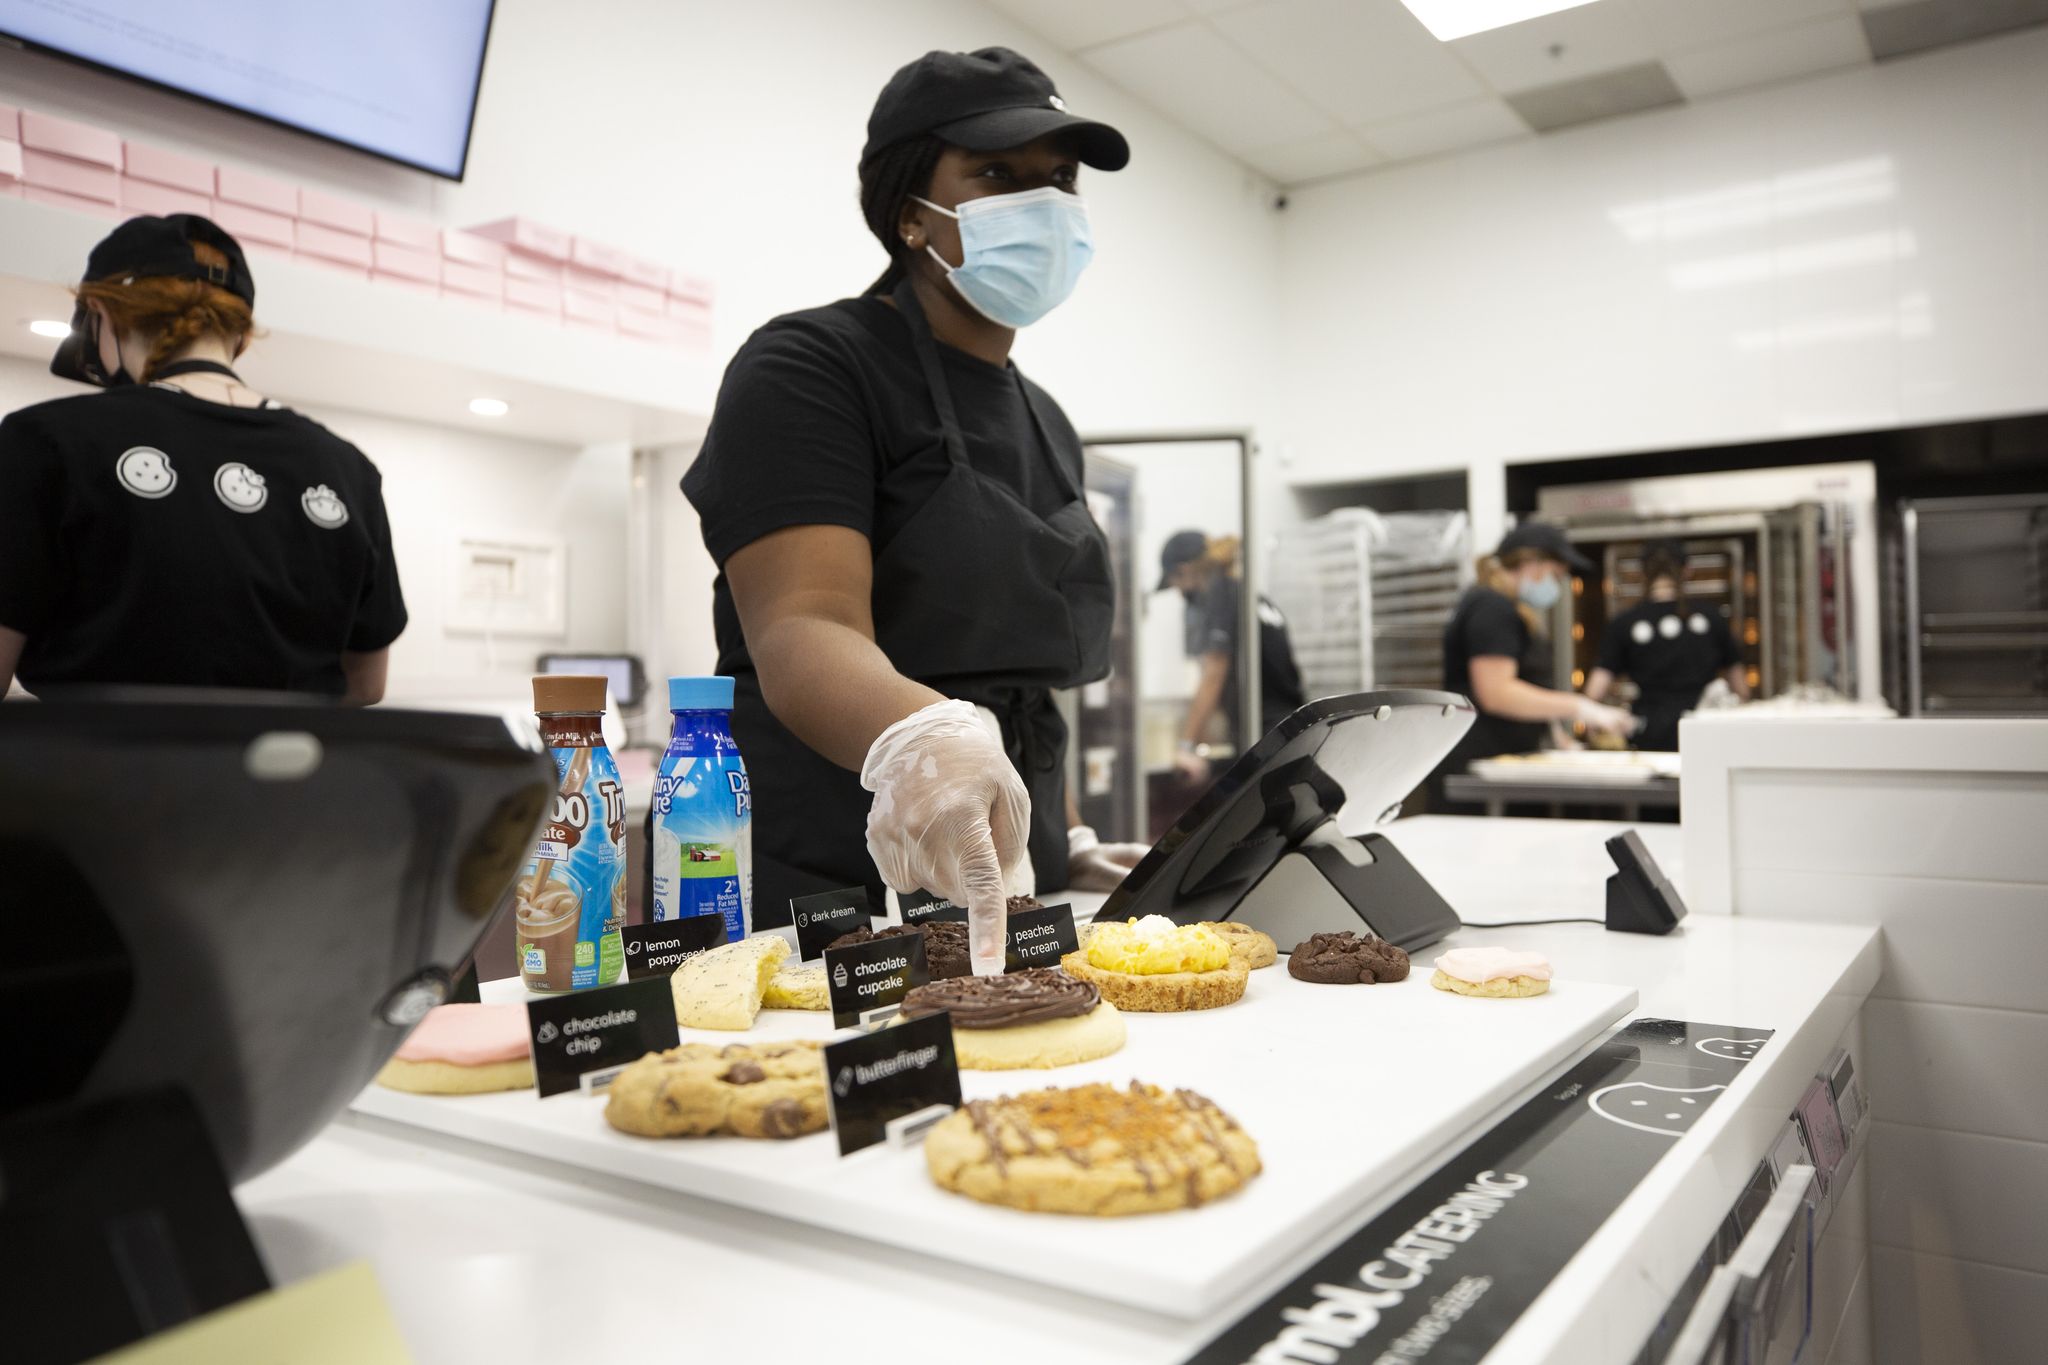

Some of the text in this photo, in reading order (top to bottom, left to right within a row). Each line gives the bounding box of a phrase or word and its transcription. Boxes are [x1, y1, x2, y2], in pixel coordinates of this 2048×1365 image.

[811, 906, 856, 923] dark dream
[907, 901, 935, 917] crumbl
[1015, 923, 1056, 945] peaches
[645, 938, 681, 952] lemon
[1030, 940, 1060, 956] cream
[525, 959, 542, 967] GMO
[527, 952, 539, 960] NO
[854, 956, 907, 977] chocolate
[857, 975, 904, 996] cupcake
[563, 1008, 637, 1037] chocolate
[565, 1034, 602, 1056] chip
[855, 1044, 938, 1086] butterfinger
[1358, 1169, 1529, 1291] CATERING
